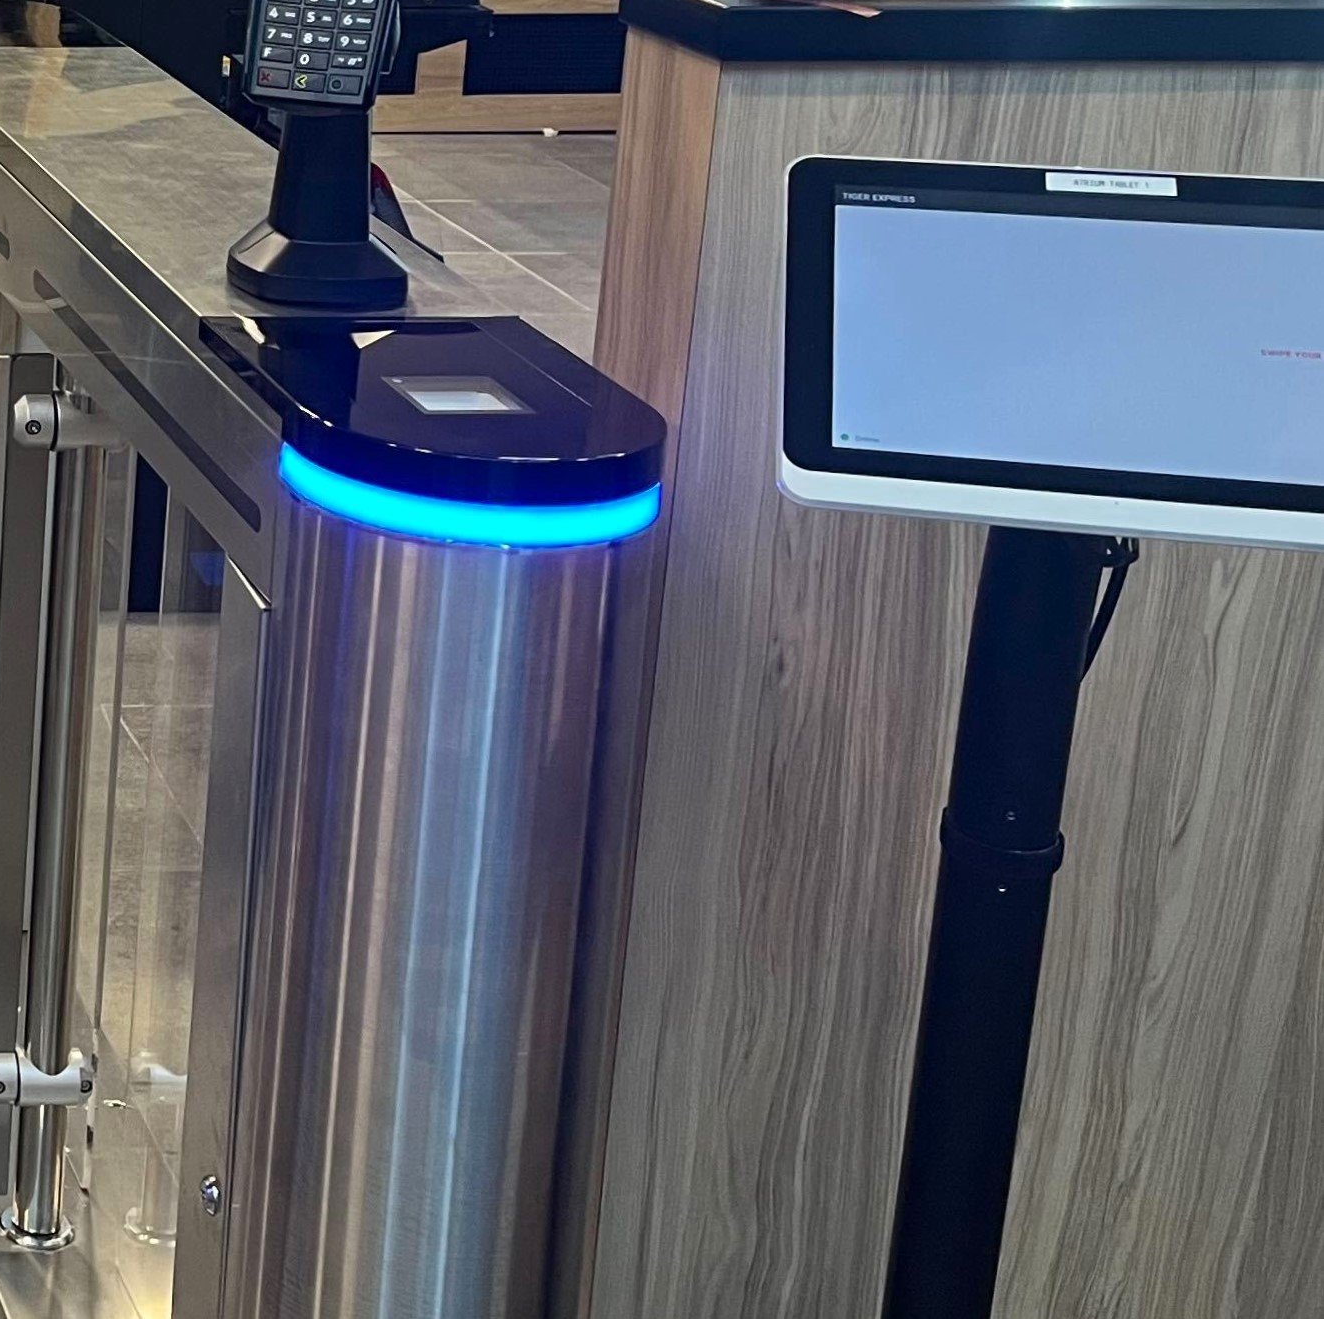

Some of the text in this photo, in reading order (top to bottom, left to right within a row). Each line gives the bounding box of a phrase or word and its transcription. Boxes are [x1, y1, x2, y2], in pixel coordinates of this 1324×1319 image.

[269, 7, 279, 18] 4
[307, 11, 315, 23] 5
[343, 14, 353, 25] 6
[267, 28, 276, 39] 7
[303, 33, 313, 44] 8
[340, 36, 350, 47] 9
[263, 47, 272, 57] F
[300, 54, 310, 65] 0
[1109, 180, 1138, 188] TABLET
[843, 192, 915, 203] TIGER EXPRESS
